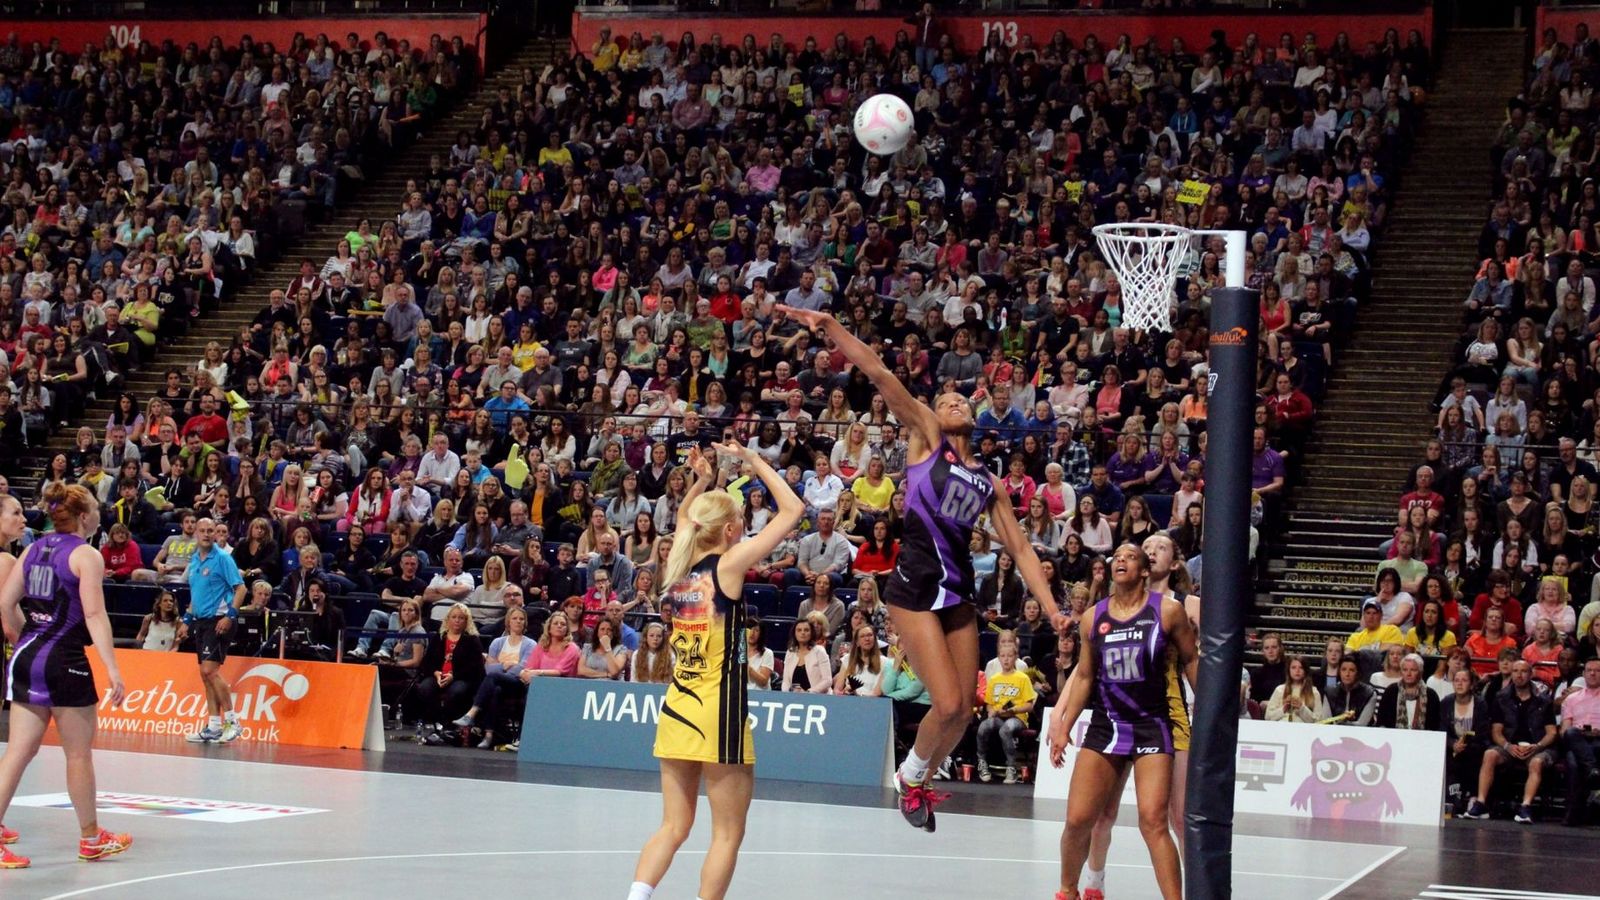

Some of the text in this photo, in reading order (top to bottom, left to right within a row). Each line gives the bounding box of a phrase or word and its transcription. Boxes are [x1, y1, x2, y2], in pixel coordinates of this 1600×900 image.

[110, 24, 141, 49] 104
[940, 480, 980, 521] GD
[28, 564, 54, 597] WD
[1336, 575, 1376, 585] TRAINER
[1282, 597, 1360, 608] JDSPORTS.CO.U
[1286, 609, 1306, 618] KING
[1309, 610, 1323, 619] OF
[1325, 612, 1360, 621] TRAINE
[672, 631, 708, 669] GA
[1105, 646, 1142, 680] GK
[99, 679, 209, 718] netba
[582, 690, 828, 736] MANSTER
